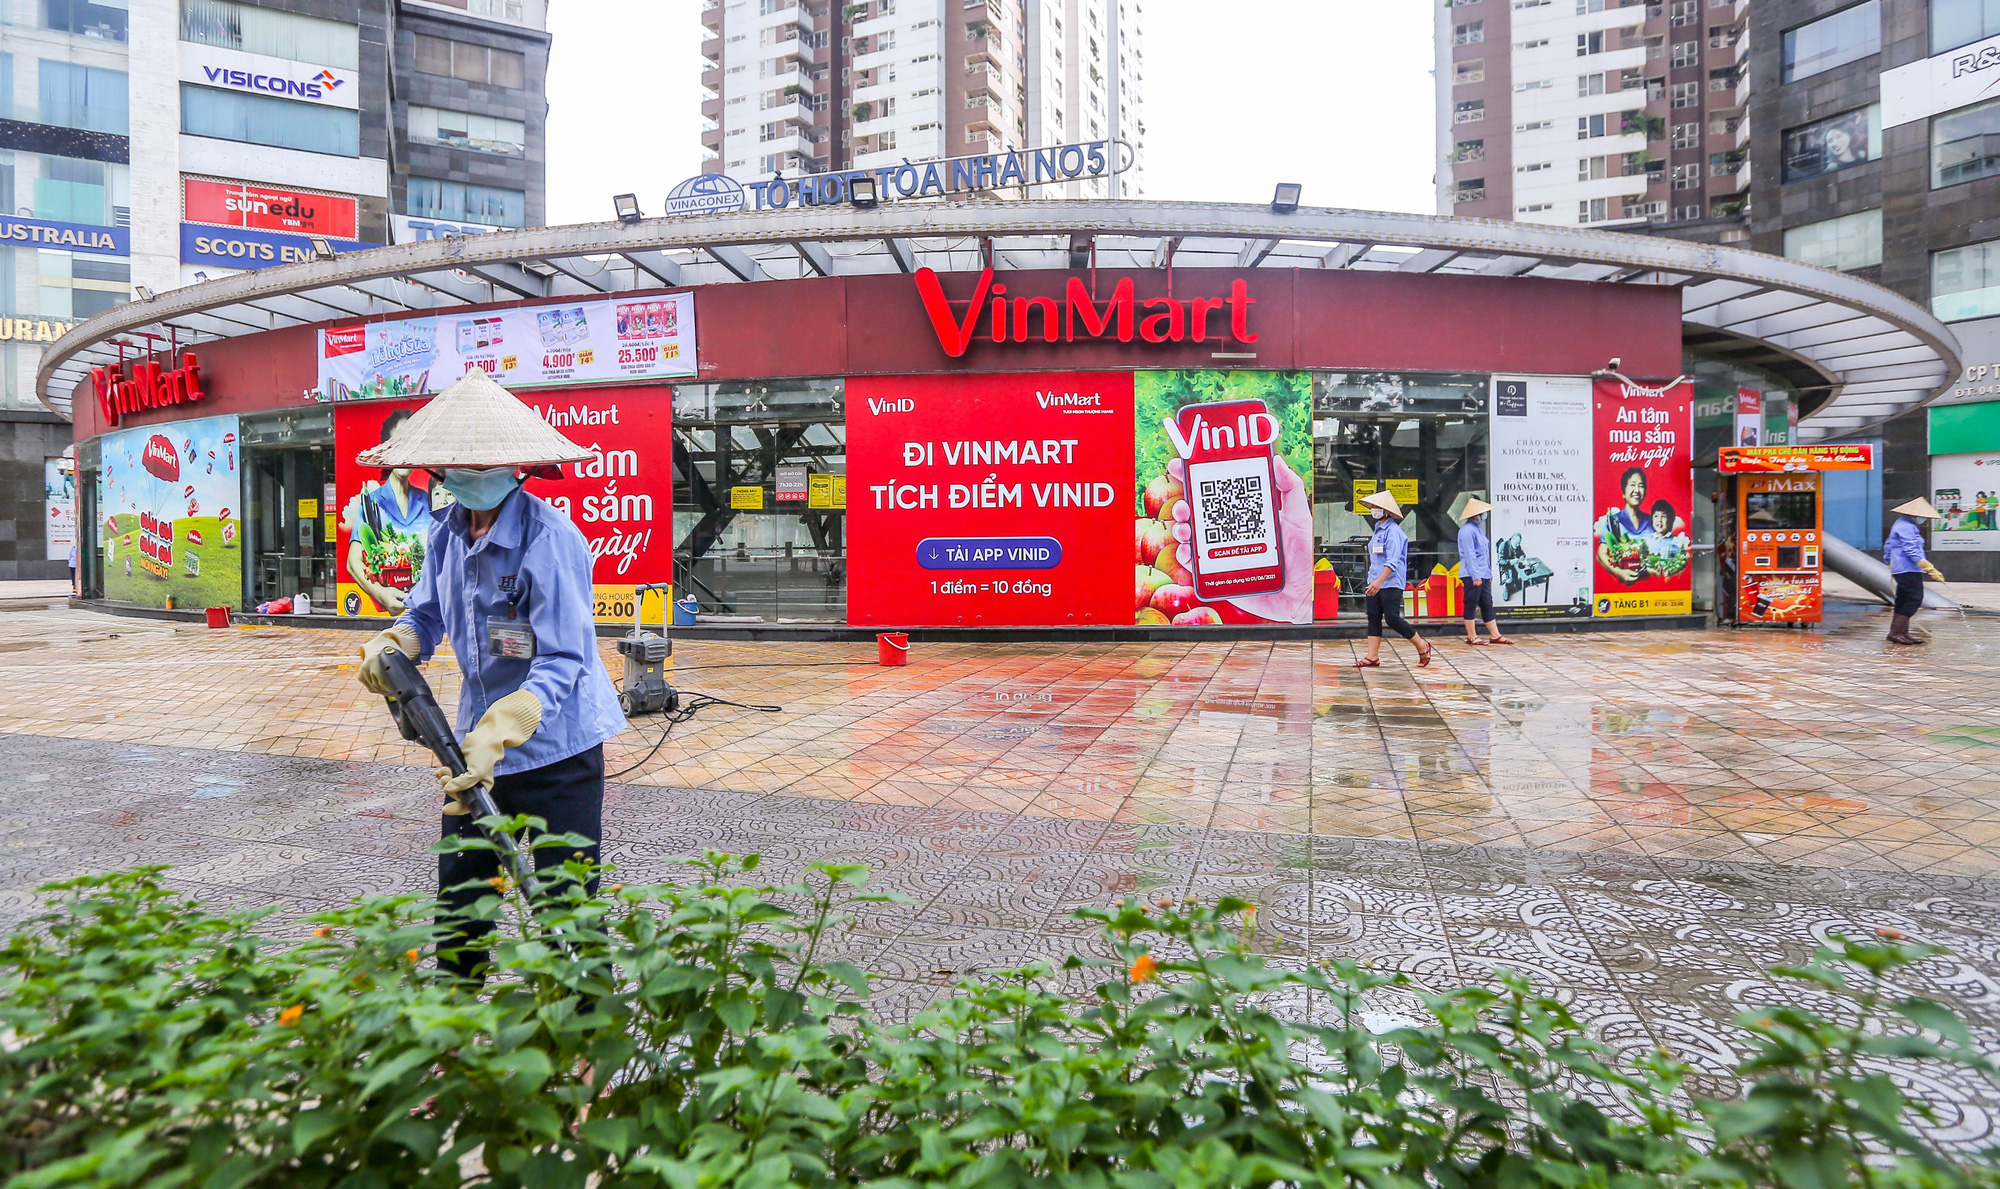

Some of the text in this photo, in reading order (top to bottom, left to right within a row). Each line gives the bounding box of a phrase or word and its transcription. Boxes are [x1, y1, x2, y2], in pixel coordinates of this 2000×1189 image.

[203, 65, 322, 98] VISICONS
[875, 157, 944, 199] TÒA
[953, 145, 1024, 193] NHÀ
[670, 193, 740, 211] VINACONEX
[195, 236, 274, 261] SCOTS
[914, 267, 1259, 357] VinMart
[327, 333, 358, 346] VinMart
[91, 352, 205, 427] VinMart
[867, 397, 915, 416] VinID
[1035, 390, 1101, 409] VinMart
[533, 403, 619, 427] VinMart
[1616, 406, 1669, 424] An tâm
[1163, 413, 1280, 460] VinID
[1609, 424, 1675, 444] mua sắm
[148, 439, 177, 469] VinMart
[903, 439, 1079, 467] ĐI VINMART
[1502, 447, 1534, 456] KHÔNG
[1609, 445, 1675, 468] mỗi ngày!
[869, 478, 939, 510] TÍCH
[948, 472, 1023, 509] ĐIỂM
[1031, 482, 1115, 508] VINID
[1503, 481, 1534, 491] HOÀNG
[1767, 478, 1816, 491] iMax
[582, 479, 654, 523] sắm
[1495, 494, 1524, 502] TRUNG
[1528, 504, 1557, 515] HÀ NỘI
[590, 528, 652, 575] gày!
[946, 544, 1050, 562] TẢI APP VINID
[1214, 549, 1230, 557] SCAN
[931, 581, 937, 594] 1
[940, 579, 977, 594] điểm
[992, 580, 1009, 594] 10
[1012, 578, 1052, 597] đồng
[1639, 600, 1649, 608] B1
